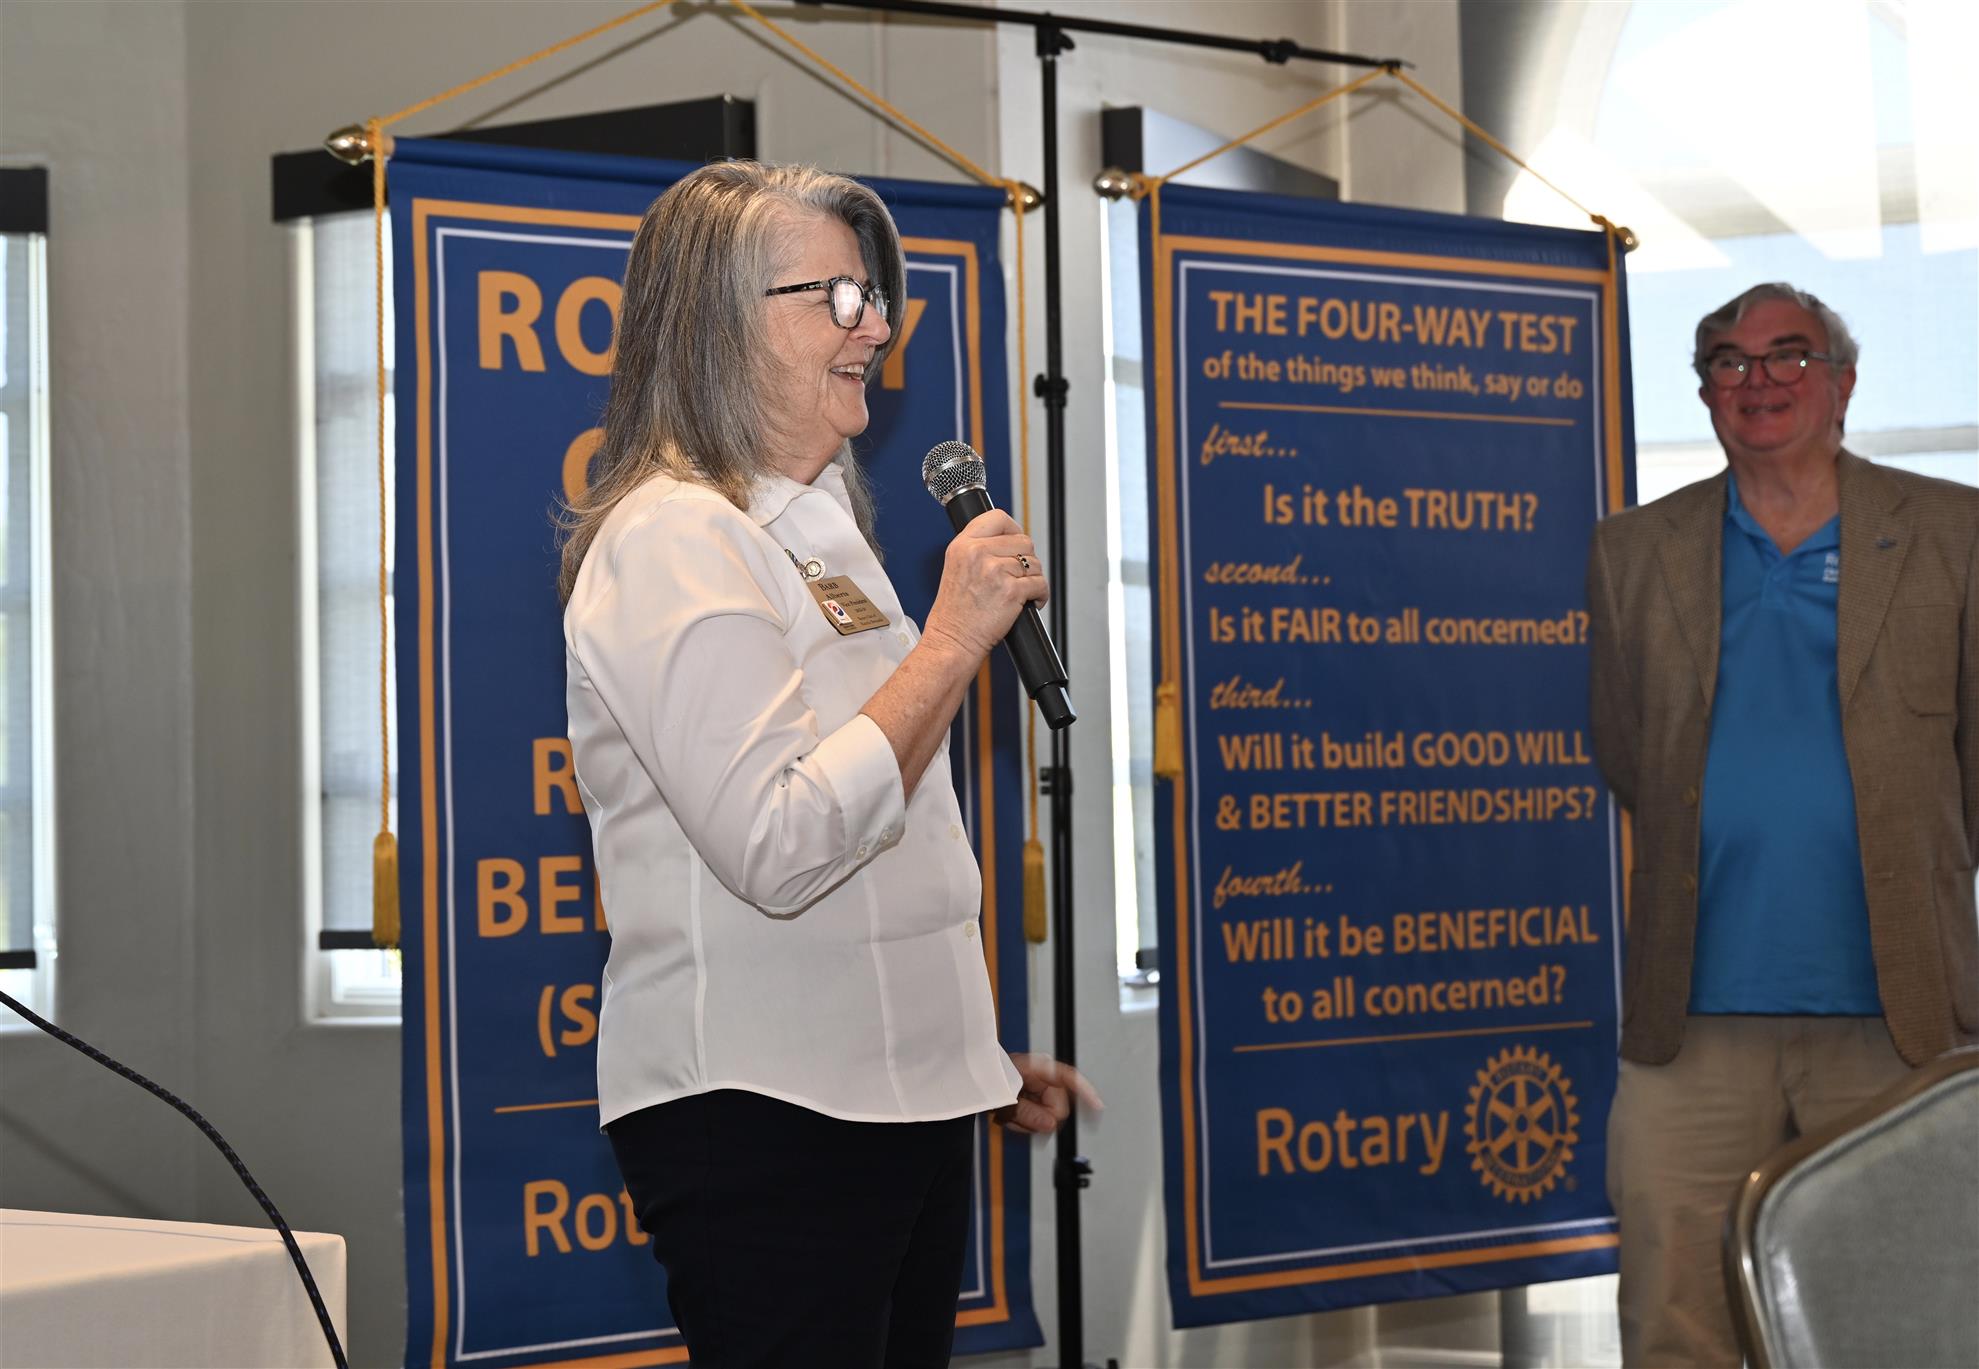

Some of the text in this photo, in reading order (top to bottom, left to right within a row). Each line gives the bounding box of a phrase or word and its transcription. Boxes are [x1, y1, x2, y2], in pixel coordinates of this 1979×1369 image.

[478, 270, 928, 389] ROY
[1209, 291, 1578, 354] THE FOUR-WAY TEST
[1203, 351, 1584, 400] of the things we think, say or do
[1201, 424, 1296, 464] first...
[1264, 484, 1538, 531] Is it the TRUTH?
[817, 582, 839, 592] BARB
[1204, 555, 1329, 584] second...
[1210, 607, 1593, 645] Is it FAIR to all concerned?
[1210, 676, 1312, 710] third...
[1219, 730, 1591, 771] Will it build GOOD WILL
[1216, 785, 1597, 831] & BETTER FRIENDSHIPS?
[1213, 862, 1332, 908] fourth...
[1222, 906, 1600, 963] Will it be BENEFICIAL
[1263, 964, 1567, 1024] to all concerned?
[1256, 1107, 1449, 1176] Rotary
